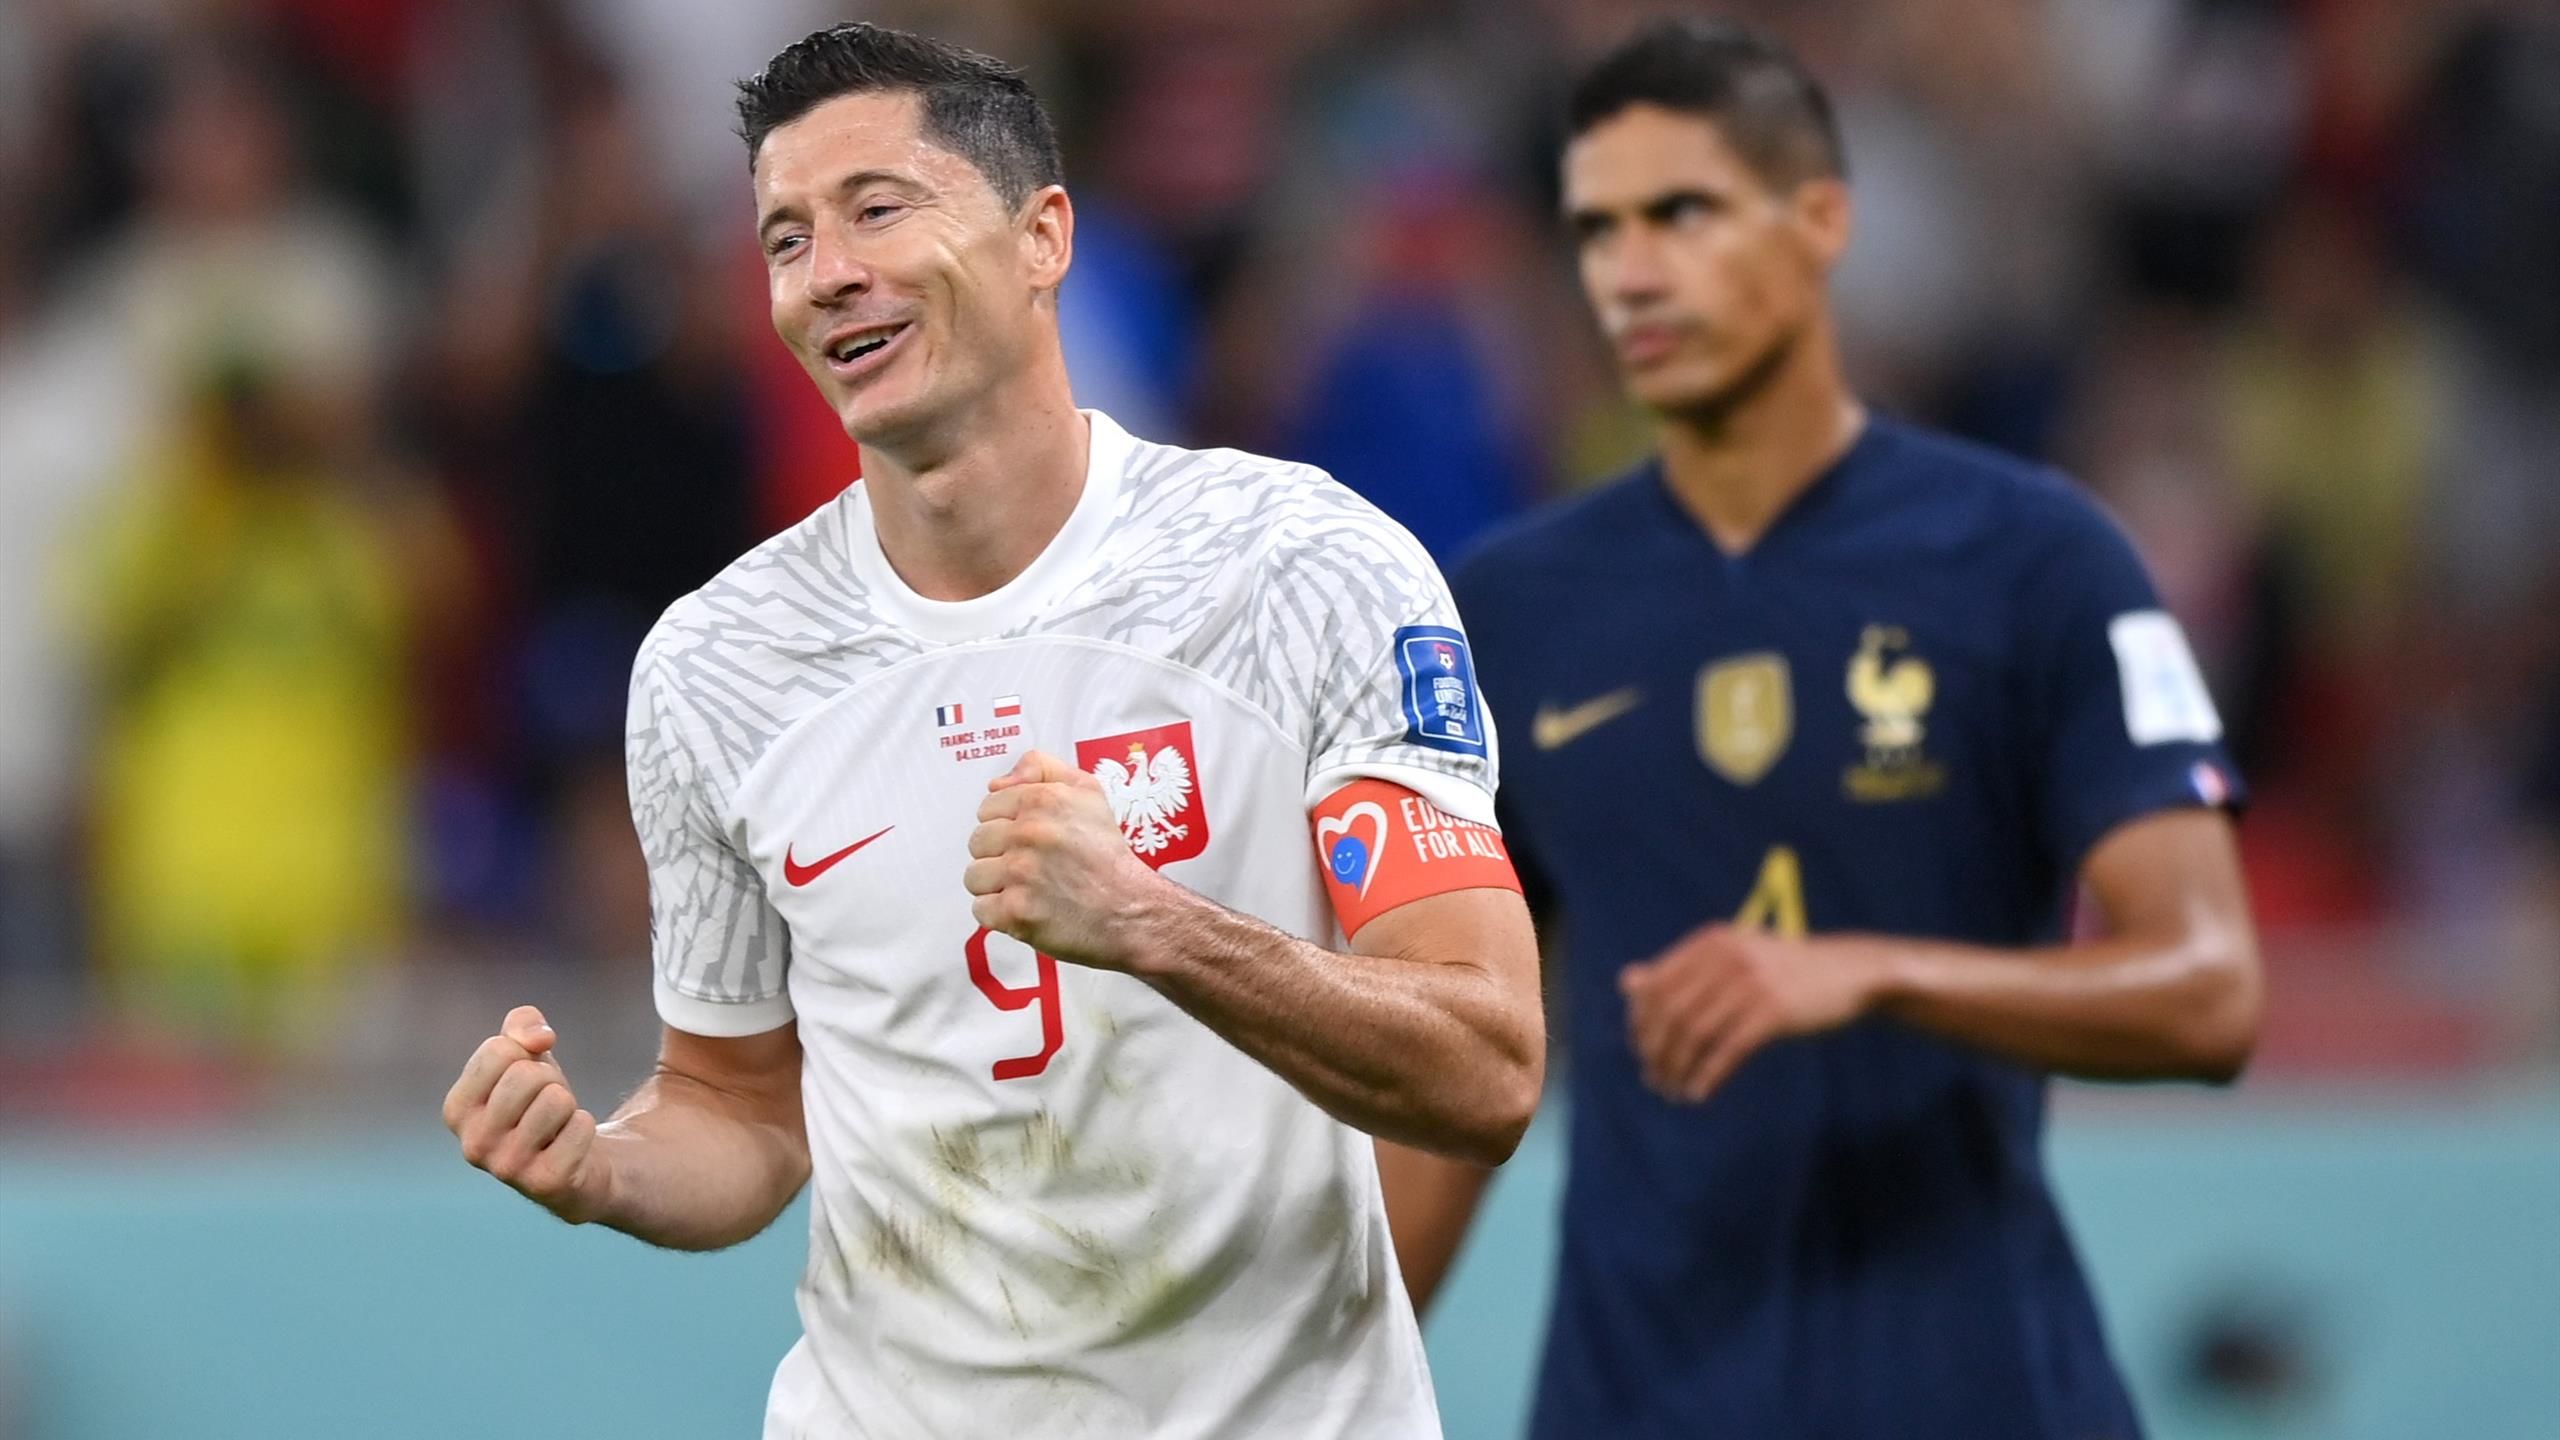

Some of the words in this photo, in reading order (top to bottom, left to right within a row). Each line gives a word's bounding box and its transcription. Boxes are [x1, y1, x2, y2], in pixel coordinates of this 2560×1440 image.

[940, 731, 975, 748] FRANCE
[983, 725, 1020, 740] POLAND
[956, 743, 1007, 761] 04.12.2022
[1412, 829, 1466, 863] FOR
[1464, 829, 1504, 860] ALL
[965, 926, 1064, 1081] 9
